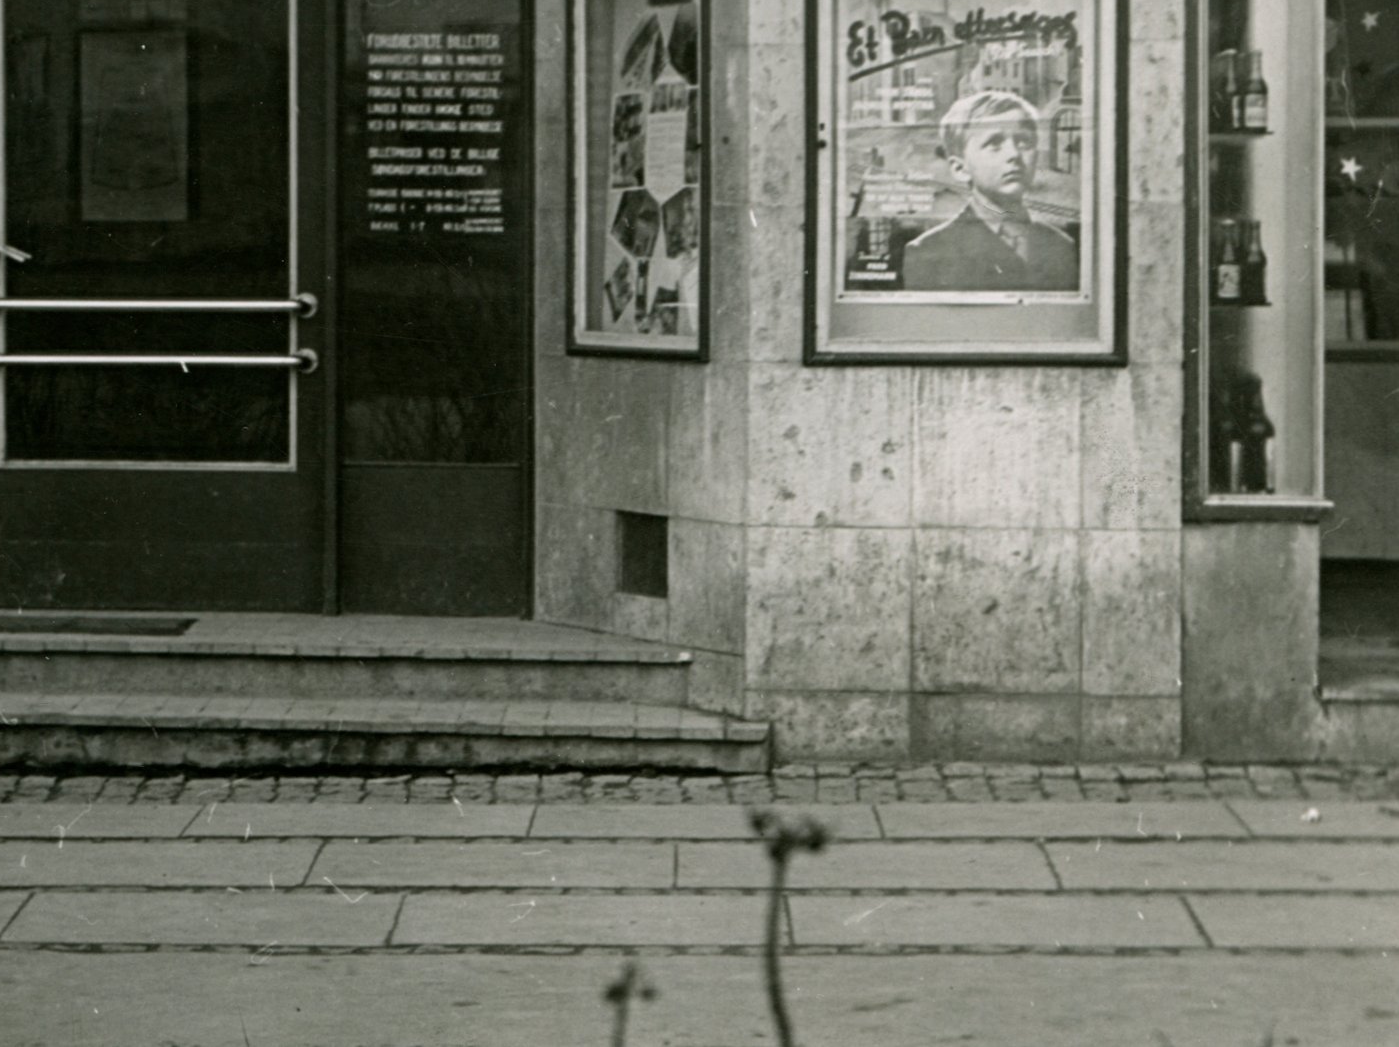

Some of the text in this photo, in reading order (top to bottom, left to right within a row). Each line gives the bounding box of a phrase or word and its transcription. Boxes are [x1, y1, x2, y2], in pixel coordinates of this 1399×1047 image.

[447, 33, 500, 49] BILLETTER
[846, 20, 879, 67] Et
[405, 86, 417, 98] TIL
[401, 103, 432, 115] FINDER
[468, 104, 494, 116] STED
[427, 147, 447, 159] VED
[450, 148, 462, 160] DE
[467, 148, 500, 160] BILLIGE
